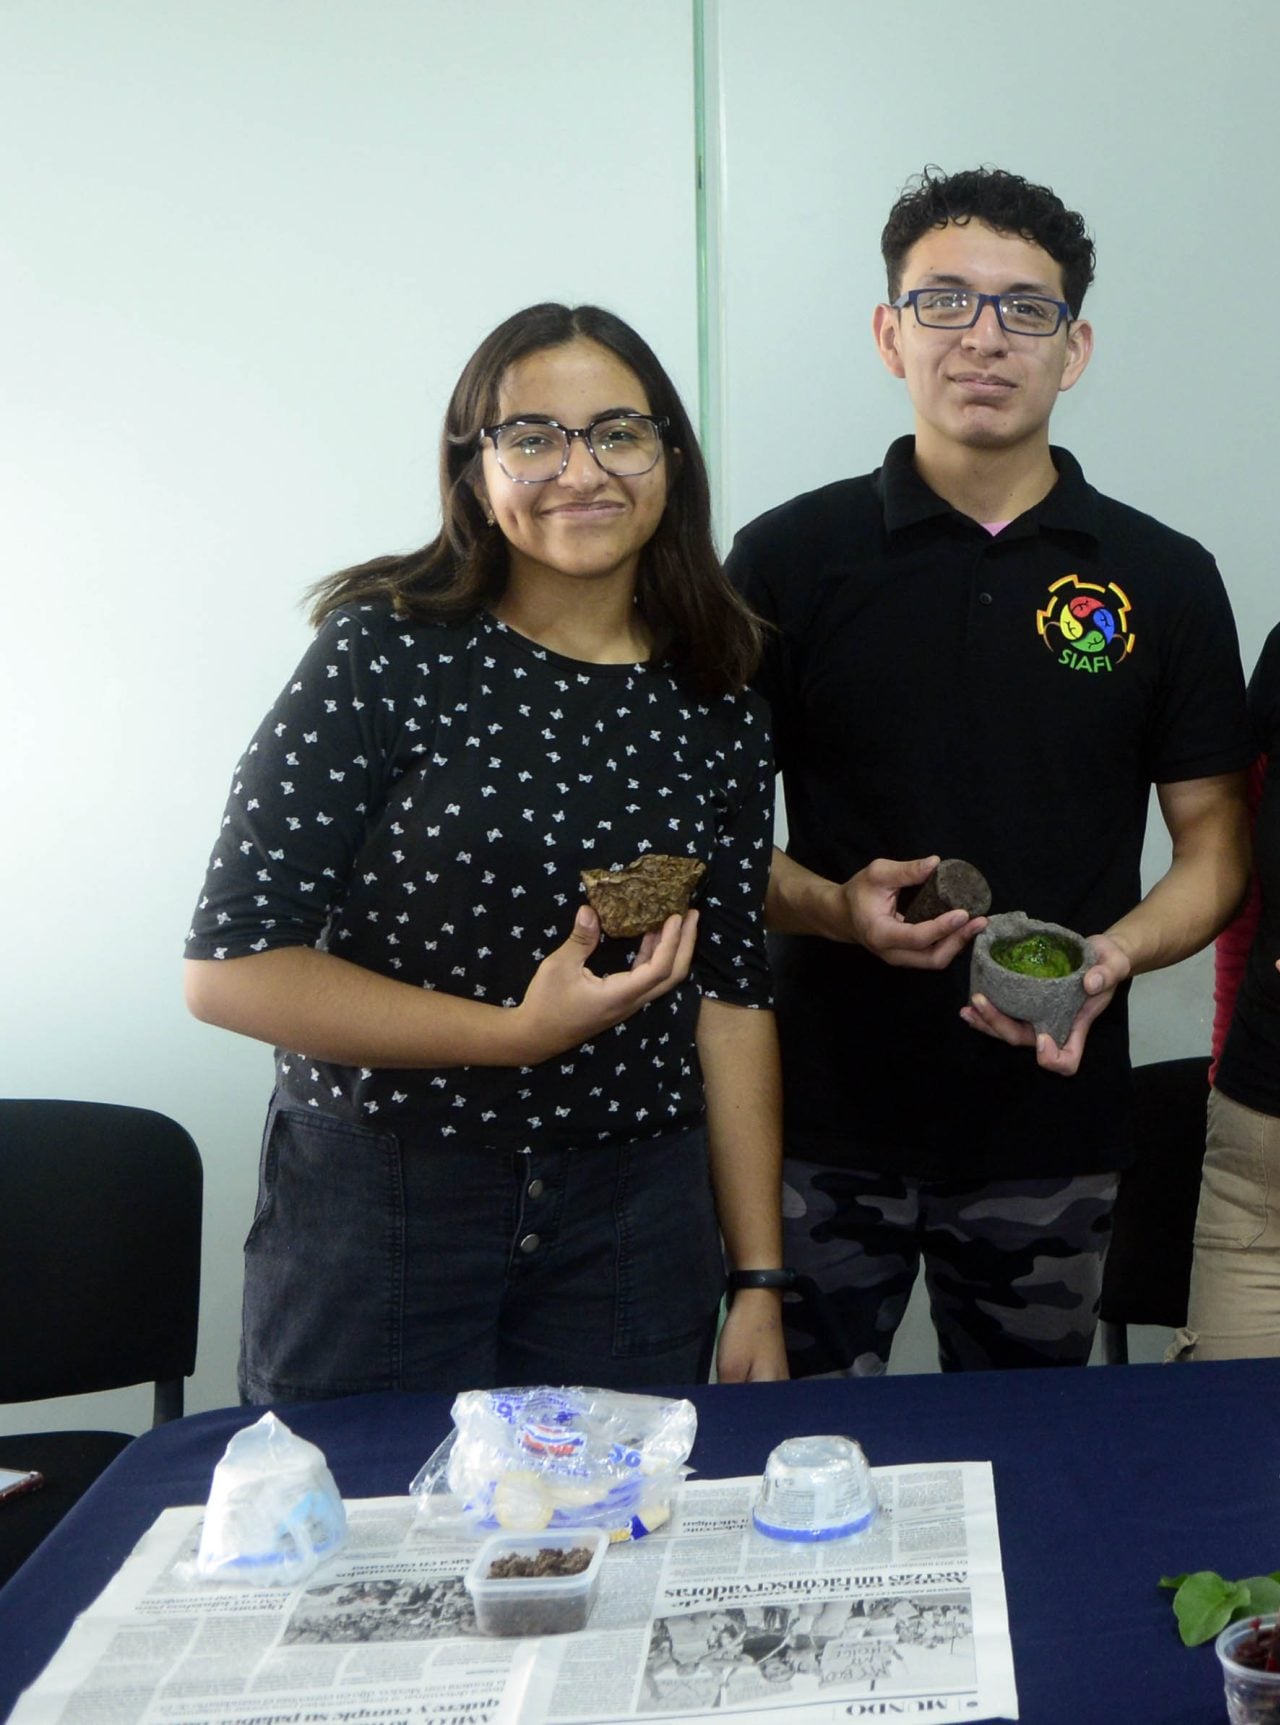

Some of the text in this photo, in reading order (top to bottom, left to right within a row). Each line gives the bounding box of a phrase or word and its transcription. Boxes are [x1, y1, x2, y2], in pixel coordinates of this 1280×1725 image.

[1058, 648, 1113, 674] SIAFI
[332, 1705, 412, 1723] cumple
[433, 1698, 499, 1713] quiere
[845, 1699, 947, 1716] MUNDO
[305, 1713, 328, 1723] su
